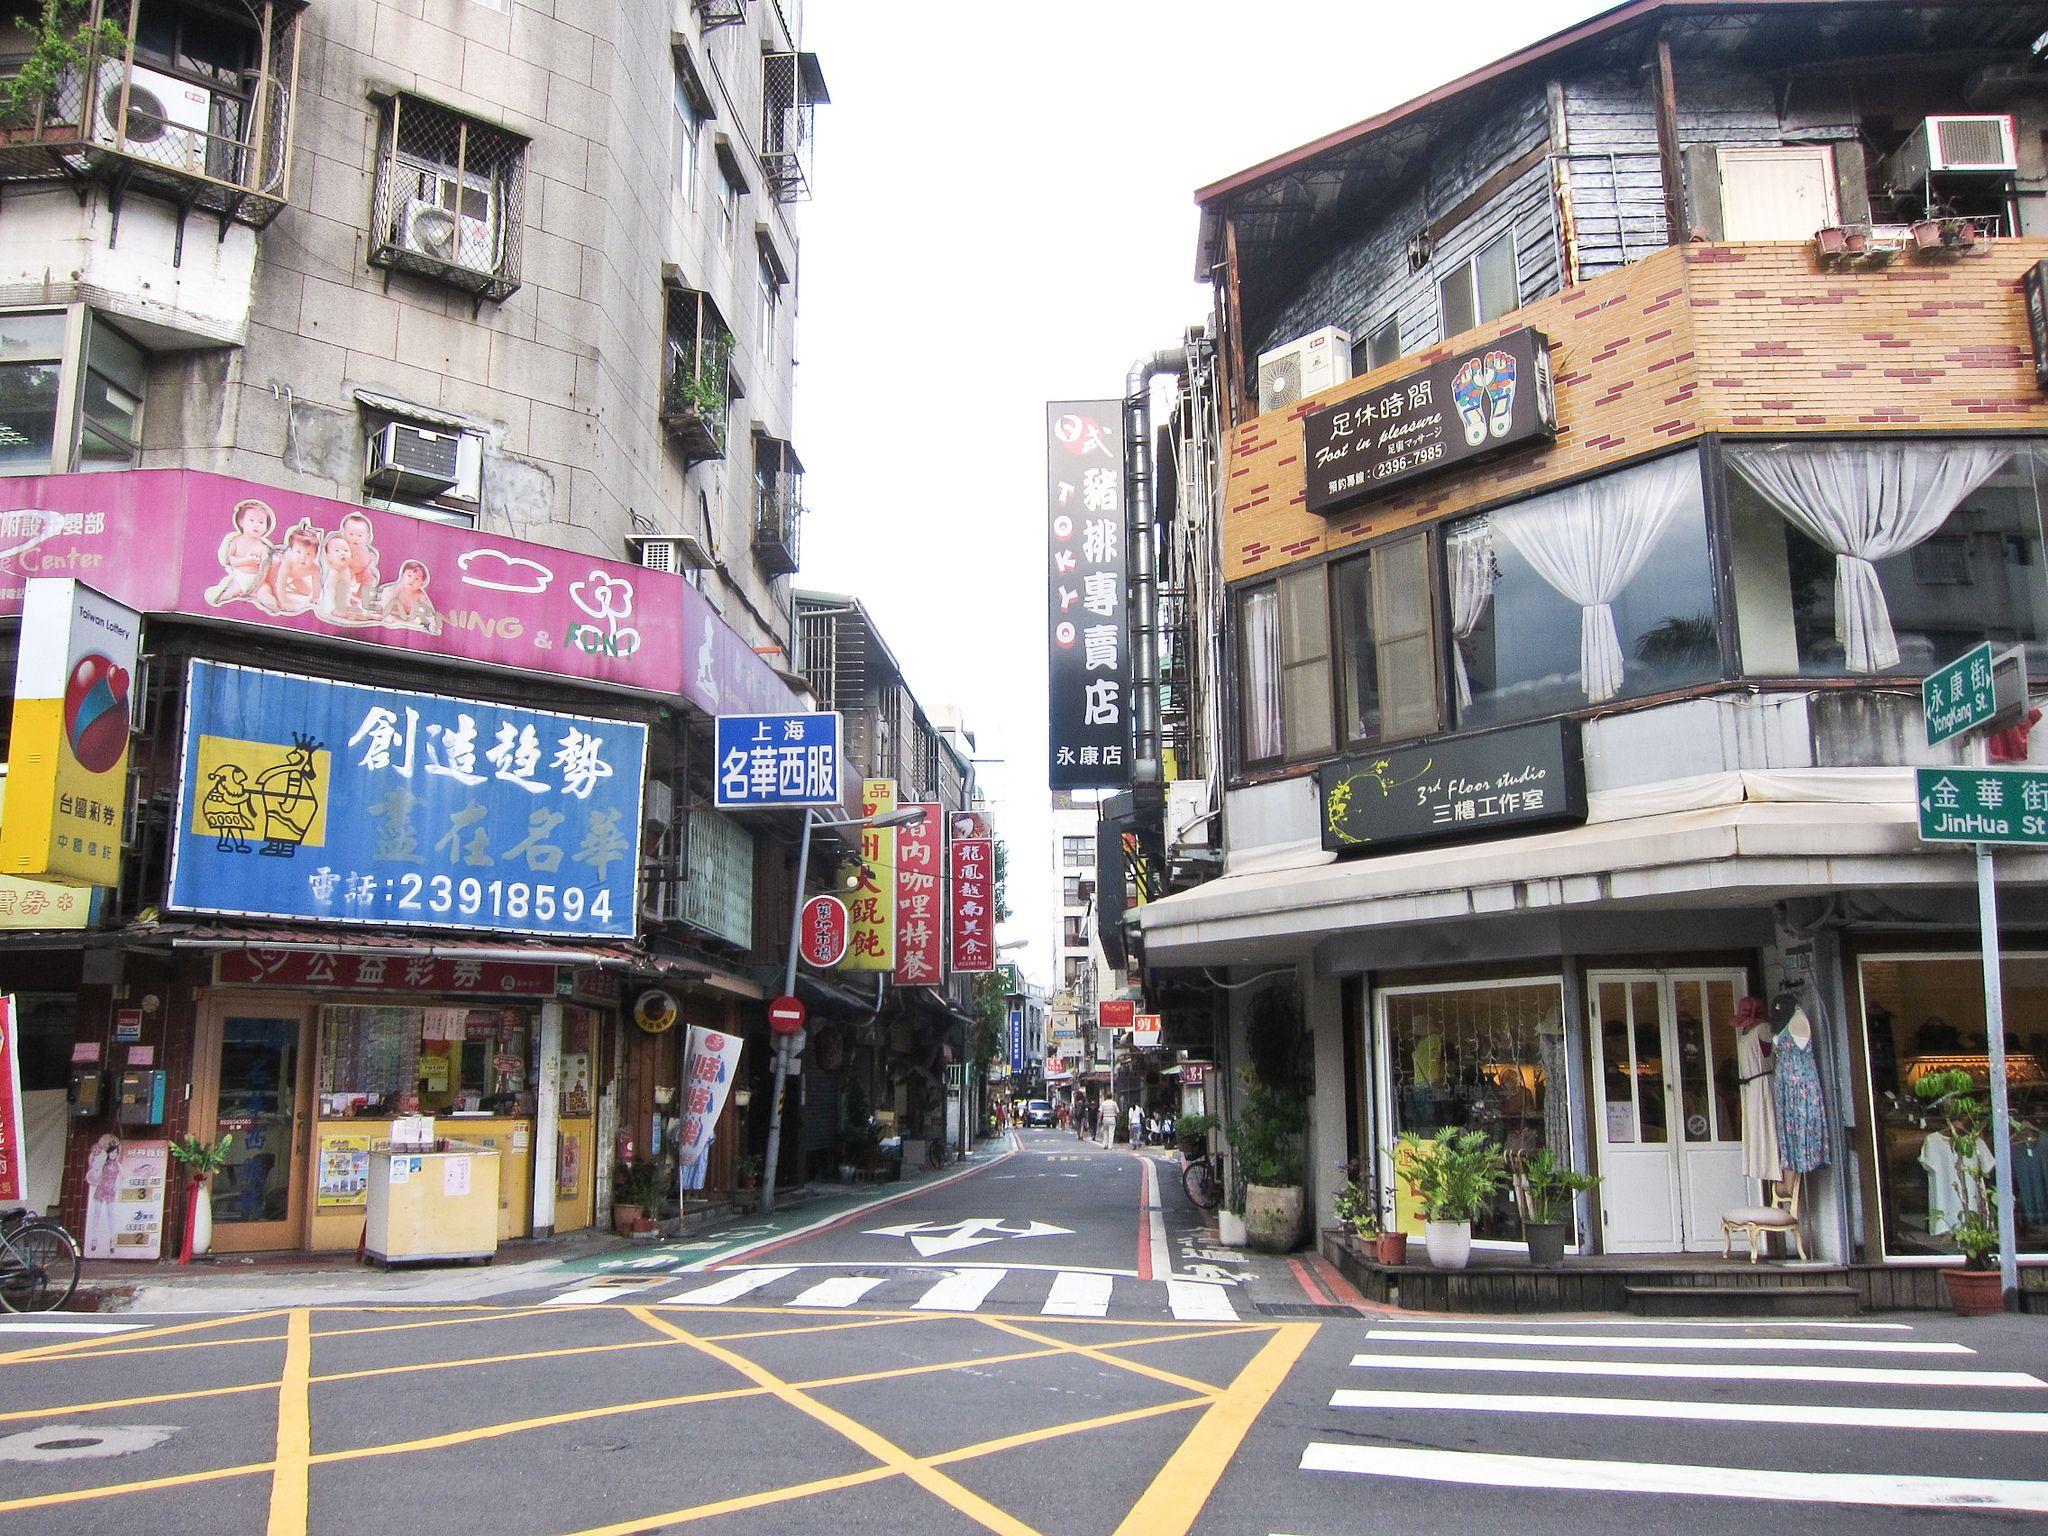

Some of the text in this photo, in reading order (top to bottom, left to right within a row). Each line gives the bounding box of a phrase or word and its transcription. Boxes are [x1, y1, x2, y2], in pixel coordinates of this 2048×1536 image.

[1330, 380, 1433, 440] 足休時間
[1315, 412, 1442, 469] Foot in pleasure
[1378, 443, 1443, 478] 2396-7985
[19, 546, 103, 572] Center
[1054, 480, 1078, 647] TOKYO
[79, 605, 131, 641] Taiwan Lottery
[1931, 658, 1986, 713] 永康街
[751, 720, 805, 741] 上海
[1931, 692, 1989, 733] YongKang St.
[721, 745, 835, 799] 名華西服
[1056, 745, 1122, 766] 永康店
[1416, 765, 1546, 806] 3rd Floor studio
[1931, 775, 2048, 812] 金華街
[1432, 788, 1544, 824] 三樓工作室
[1934, 813, 2009, 834] JinHua
[58, 834, 111, 860] 中國信託
[959, 845, 987, 954] 龍鳳越南美食
[306, 952, 483, 988] 公益彩券
[138, 1188, 146, 1199] 3
[136, 1233, 144, 1245] 2
